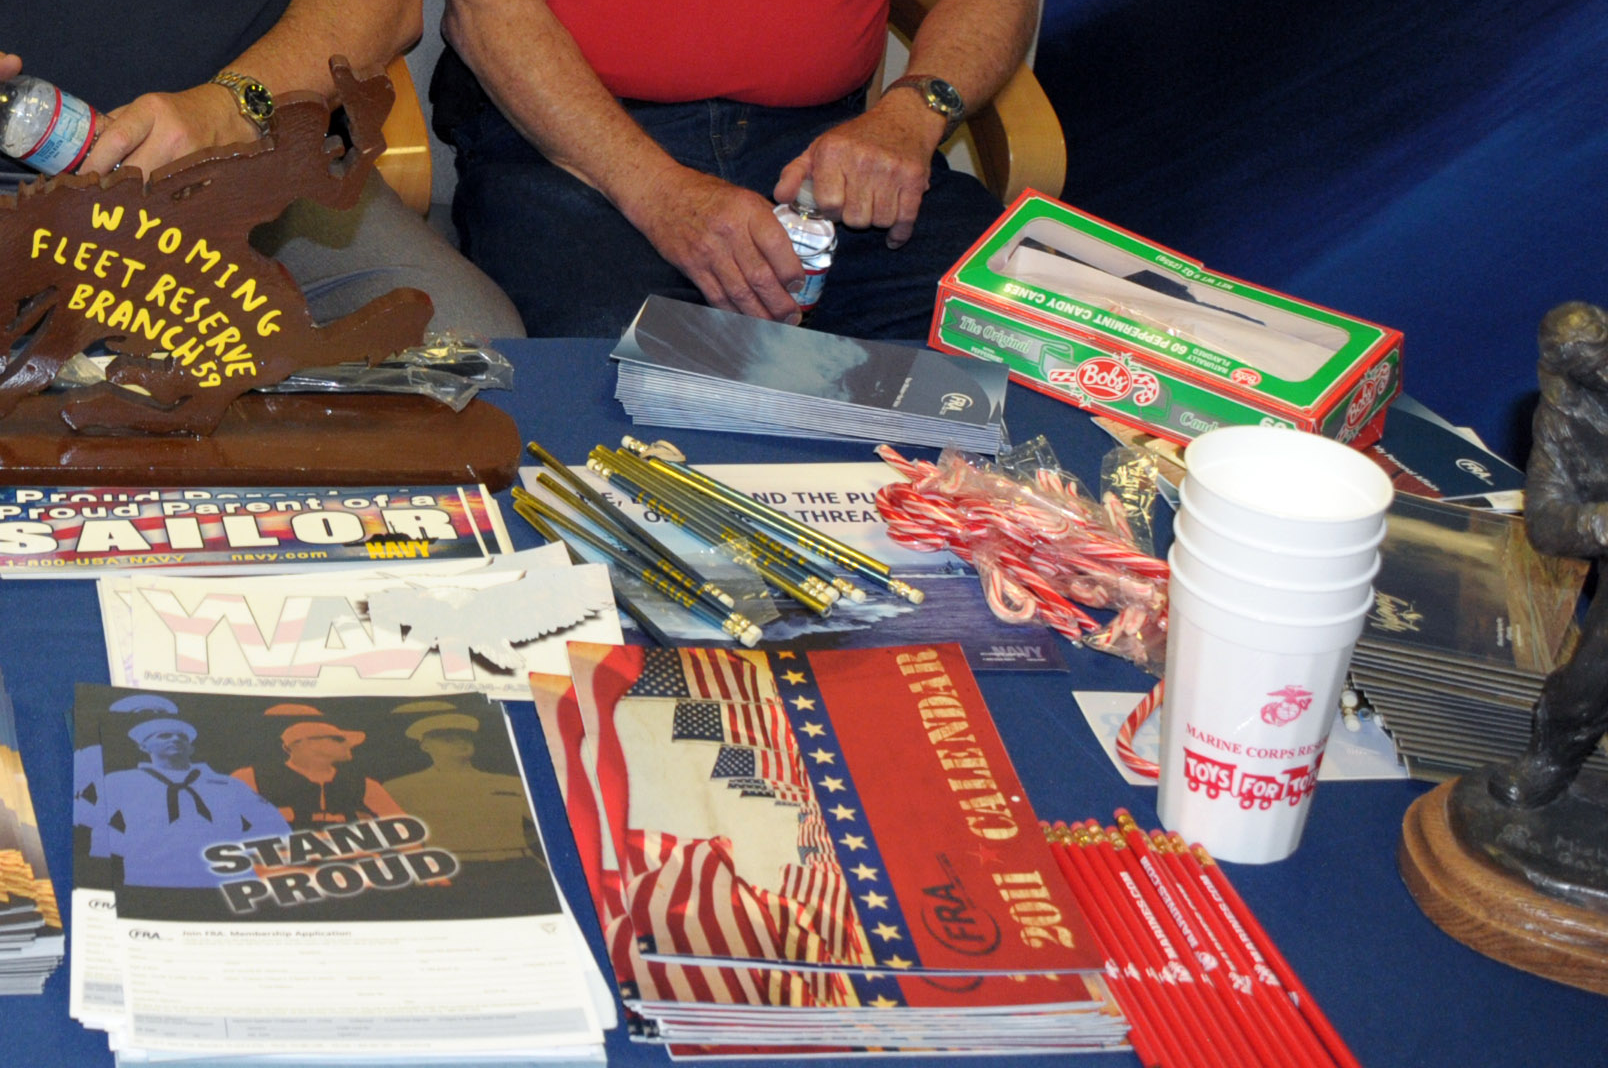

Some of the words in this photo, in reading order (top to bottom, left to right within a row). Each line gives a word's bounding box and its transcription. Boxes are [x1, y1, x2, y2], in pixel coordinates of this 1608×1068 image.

[92, 202, 282, 336] WYOMING
[31, 228, 146, 288] FLEET
[145, 274, 257, 377] RESERVE
[1003, 283, 1047, 304] CANES
[1046, 299, 1093, 320] CANDY
[68, 284, 205, 366] BRANCH
[191, 360, 222, 387] 59
[959, 316, 982, 335] The
[983, 324, 1032, 353] Original
[1093, 314, 1171, 352] PEPPERMINT
[1171, 340, 1188, 355] 60
[1193, 348, 1232, 366] FLAVORED
[1186, 355, 1229, 374] NATURALLY
[1082, 364, 1128, 393] Bobs
[1180, 412, 1219, 432] Cand
[162, 497, 325, 516] Parent
[342, 493, 390, 509] of
[410, 495, 437, 508] a
[752, 492, 787, 505] ND
[793, 492, 841, 505] THE
[794, 510, 886, 523] THREA
[5, 555, 185, 568] 1-800-USA-NAVY
[231, 550, 328, 562] navy.com
[365, 540, 431, 560] NAVY
[991, 645, 1043, 658] NAVY
[896, 649, 1019, 841] CALENDAR
[1186, 722, 1242, 754] MARINE
[1246, 746, 1295, 759] CORPS
[1186, 757, 1230, 788] TOYS
[1241, 777, 1279, 799] FOR
[203, 815, 430, 874] STAND
[219, 850, 460, 913] PROUD
[924, 880, 976, 944] FRA
[993, 869, 1074, 950] 2011
[1140, 855, 1199, 948] MARINES.COM
[133, 930, 161, 940] FRA
[230, 931, 293, 939] Membership
